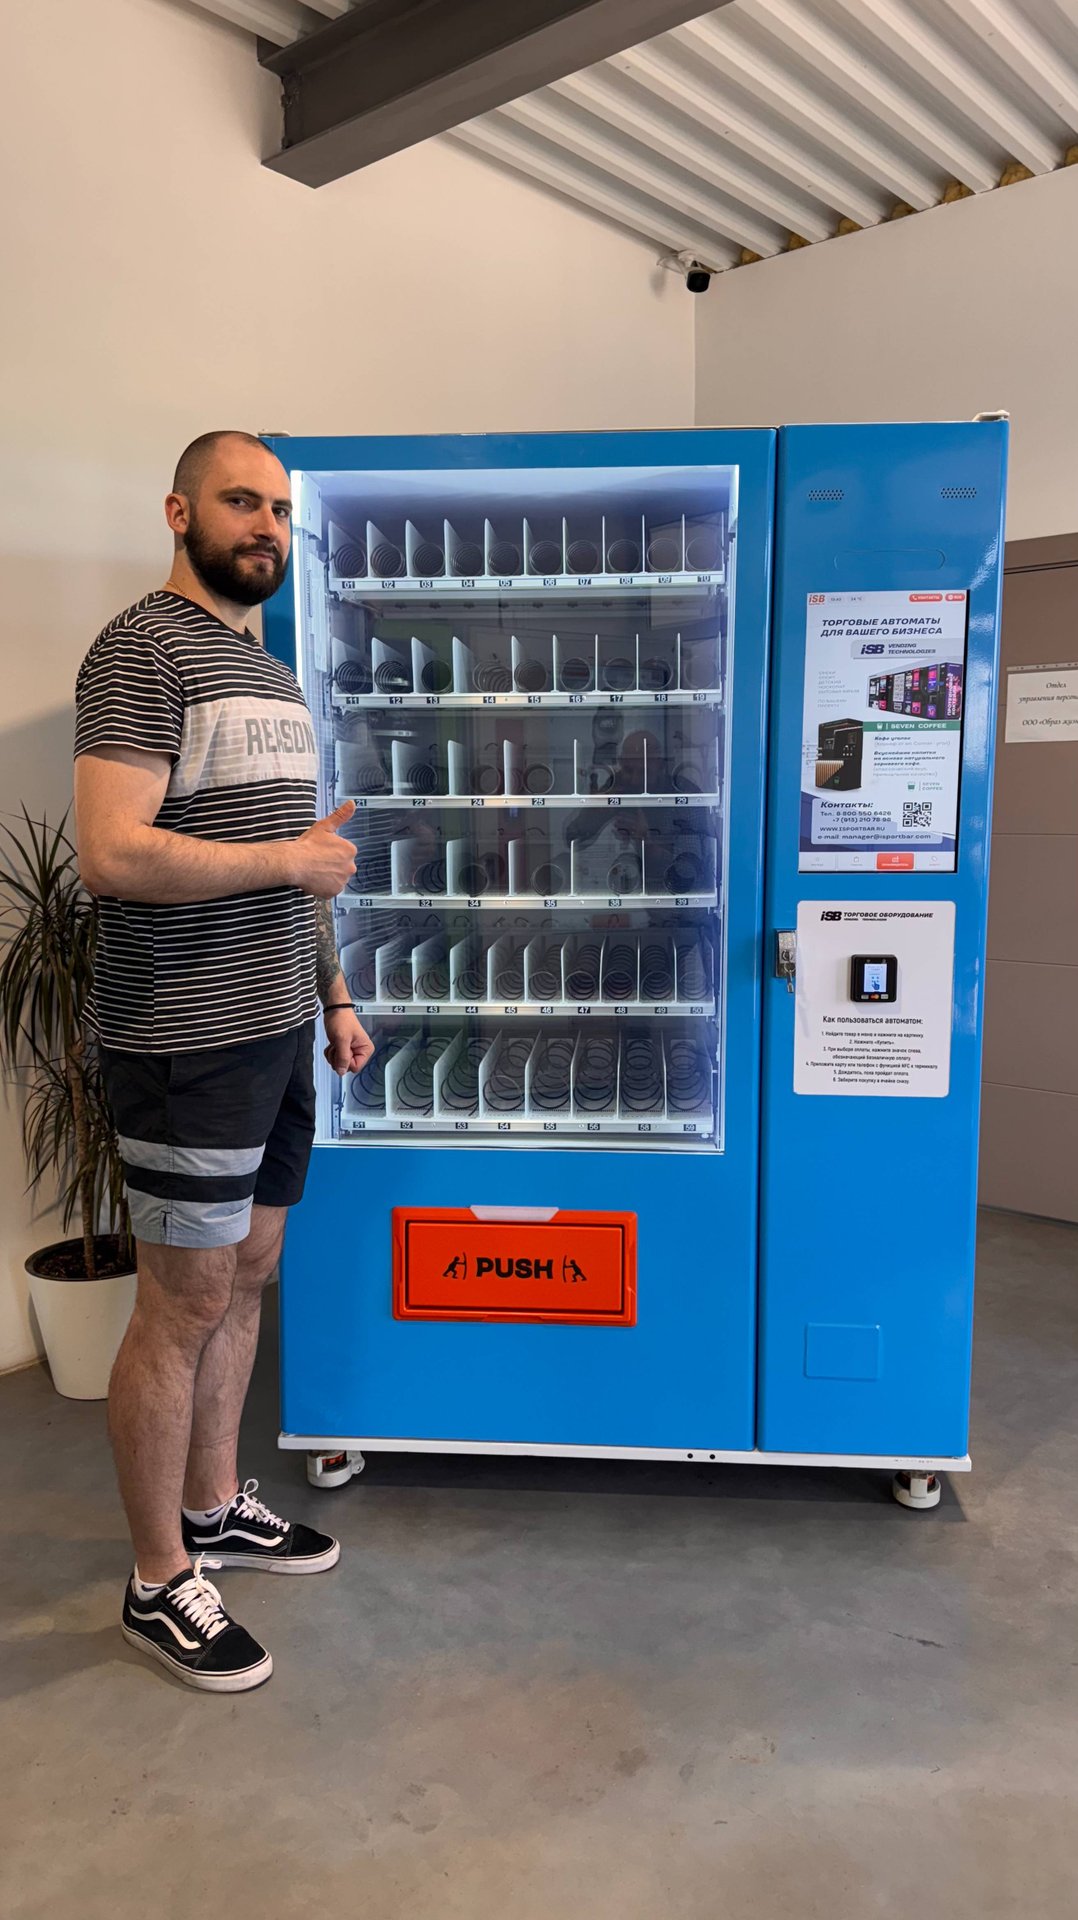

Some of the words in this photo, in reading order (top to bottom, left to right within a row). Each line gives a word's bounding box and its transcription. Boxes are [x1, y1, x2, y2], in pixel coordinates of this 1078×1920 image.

[861, 644, 885, 654] iSB
[820, 911, 842, 921] iSB
[476, 1257, 554, 1280] PUSH
